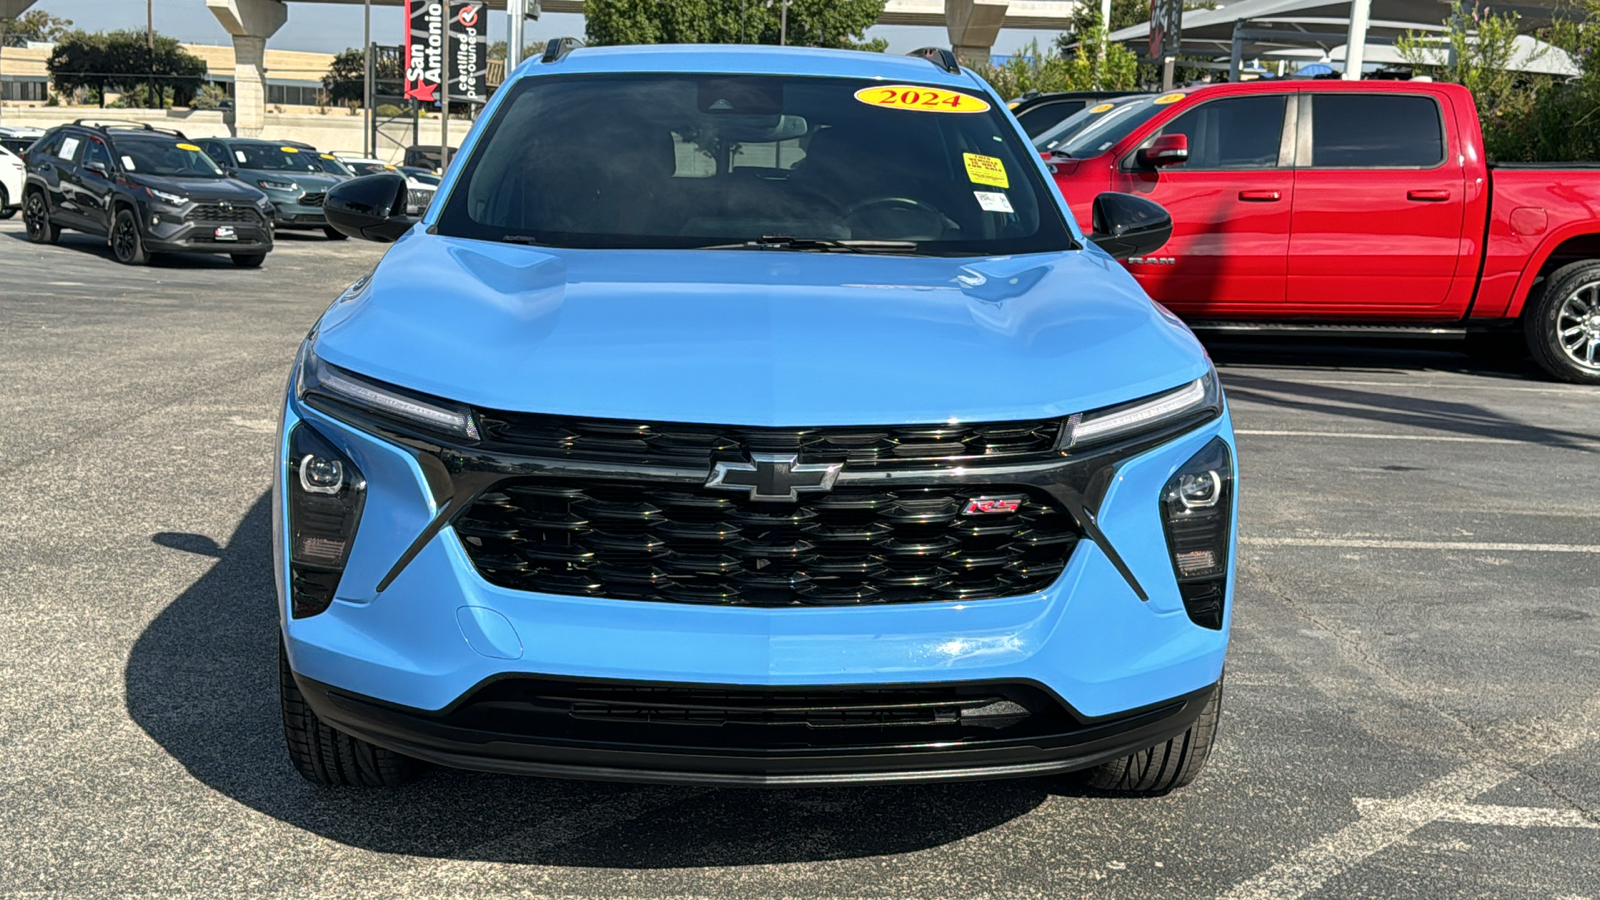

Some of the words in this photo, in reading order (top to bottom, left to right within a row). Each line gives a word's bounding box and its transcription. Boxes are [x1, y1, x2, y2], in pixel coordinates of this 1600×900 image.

[424, 3, 442, 84] Antonio
[457, 33, 468, 91] certified
[406, 44, 425, 81] San
[466, 27, 478, 99] pre-owned
[879, 90, 961, 107] 2024
[1128, 257, 1175, 265] RAM
[966, 499, 1021, 515] RS
